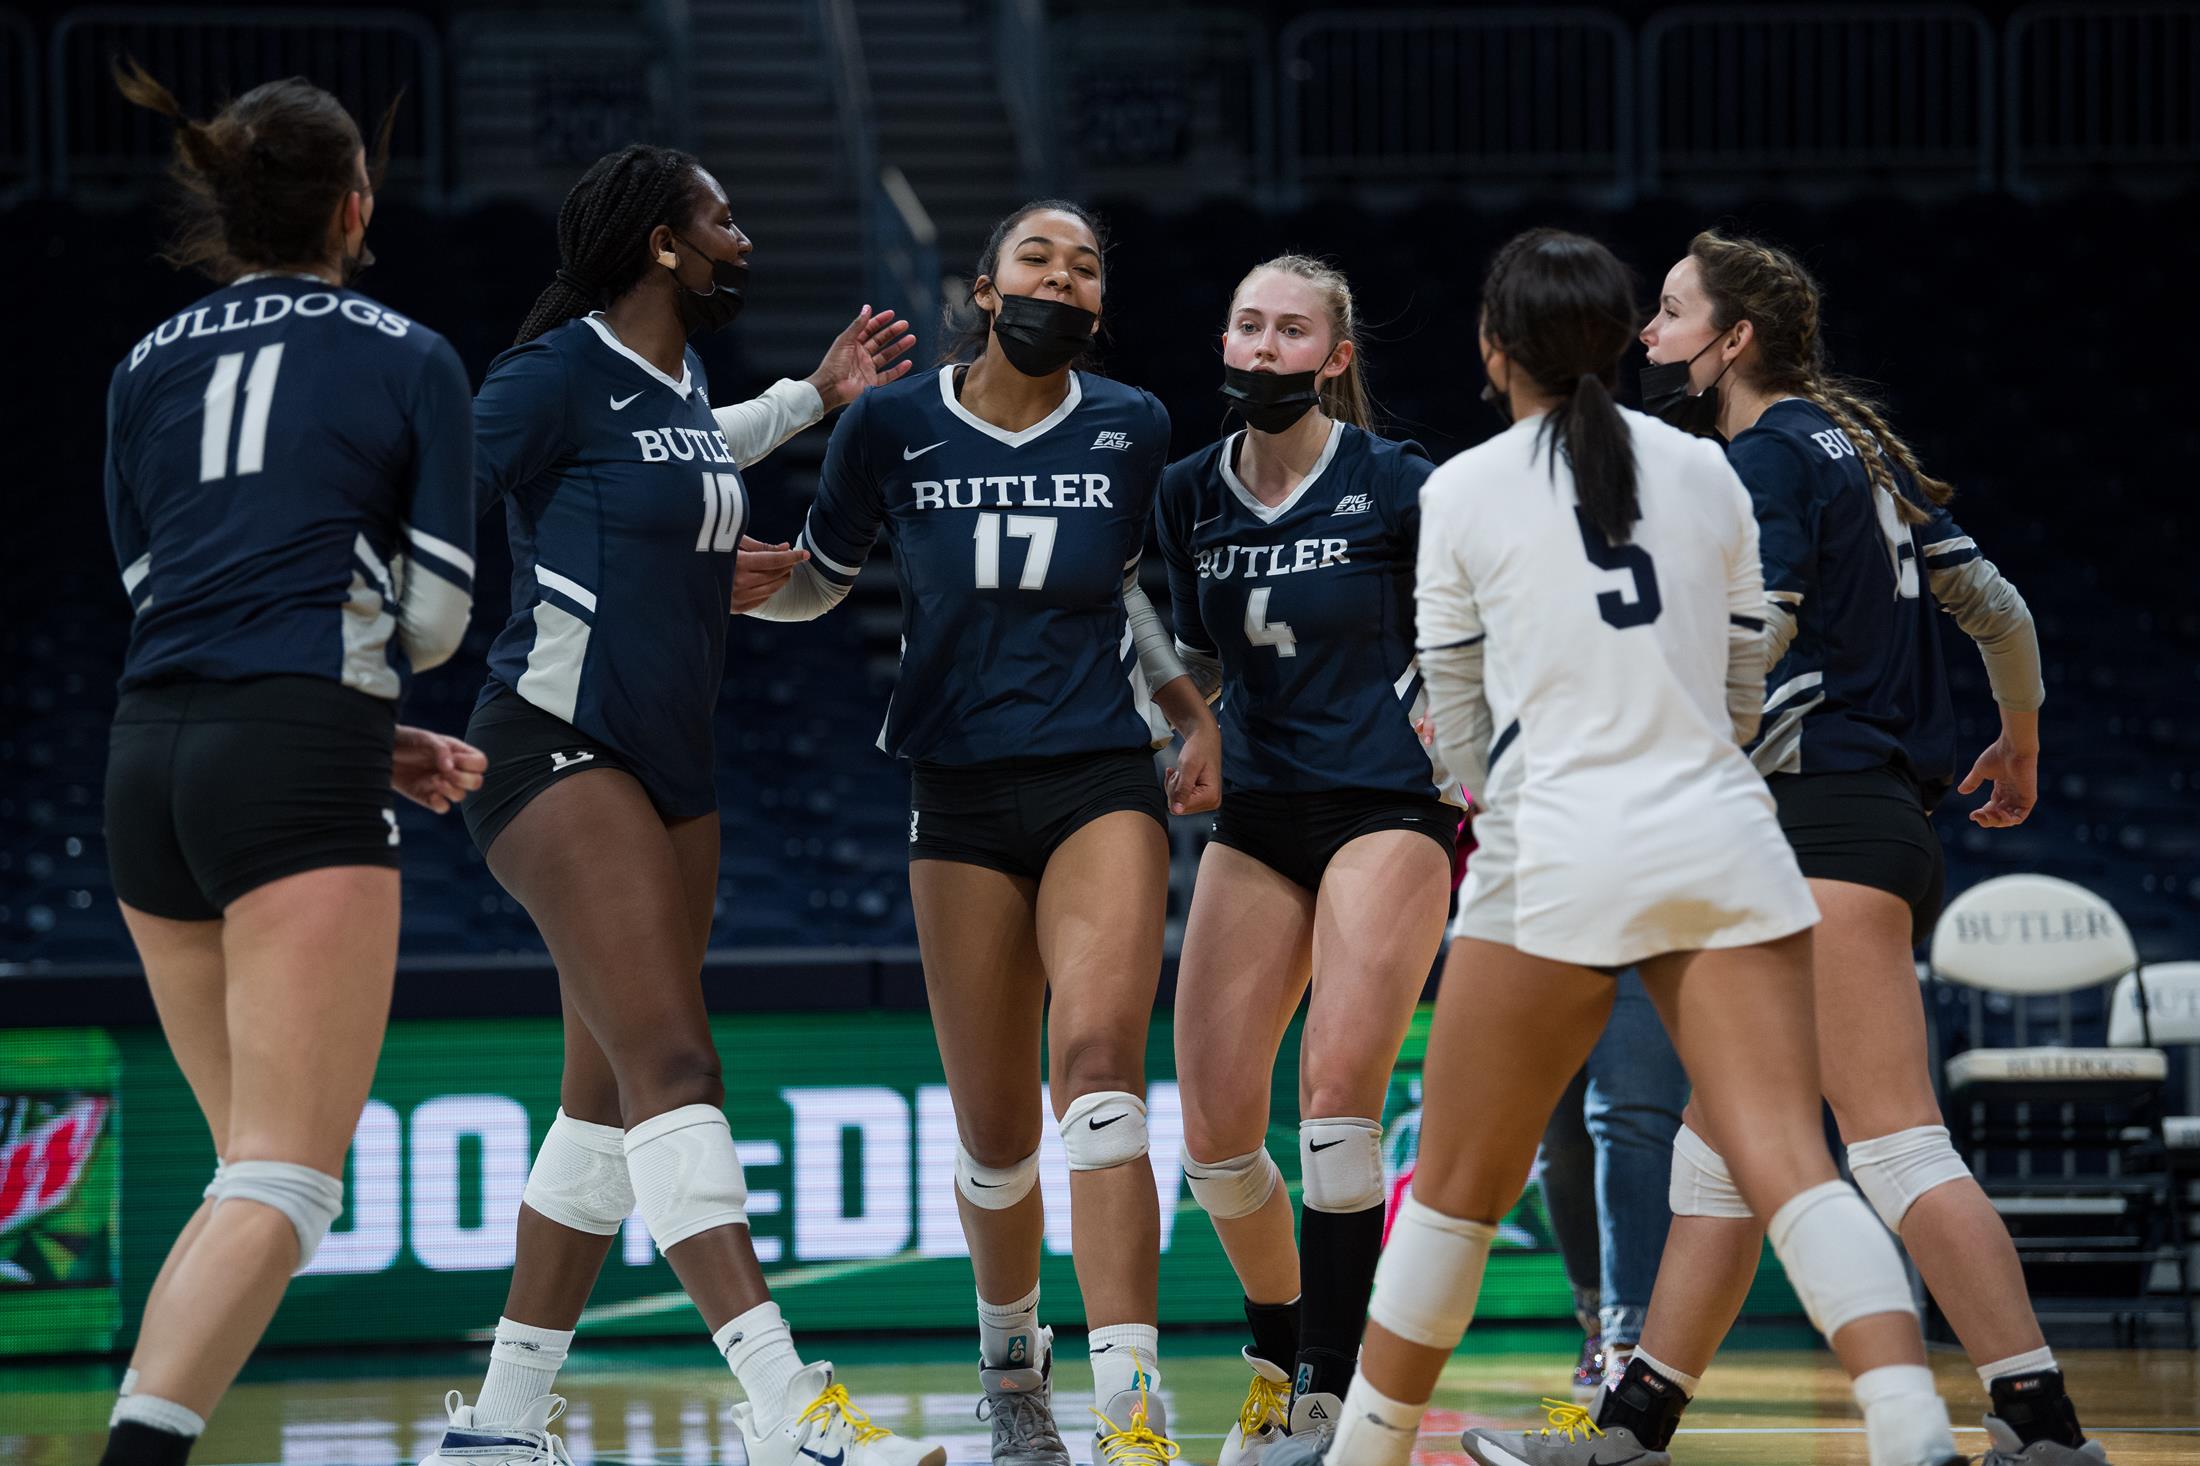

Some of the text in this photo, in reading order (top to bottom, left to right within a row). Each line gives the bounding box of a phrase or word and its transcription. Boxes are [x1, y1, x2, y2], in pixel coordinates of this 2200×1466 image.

[128, 292, 411, 373] BULLDOGS
[200, 342, 285, 483] 11
[632, 426, 737, 464] BUTLE
[1094, 439, 1133, 450] EAST
[1098, 430, 1128, 441] BIG
[695, 471, 744, 552] 10
[911, 473, 1114, 510] BUTLER
[1334, 500, 1374, 513] EAST
[1340, 493, 1368, 506] BIG
[972, 512, 1058, 591] 17
[1194, 538, 1351, 580] BUTLER
[1574, 504, 1663, 630] 5
[1244, 586, 1298, 658] 4
[1955, 907, 2114, 946] BUTLER
